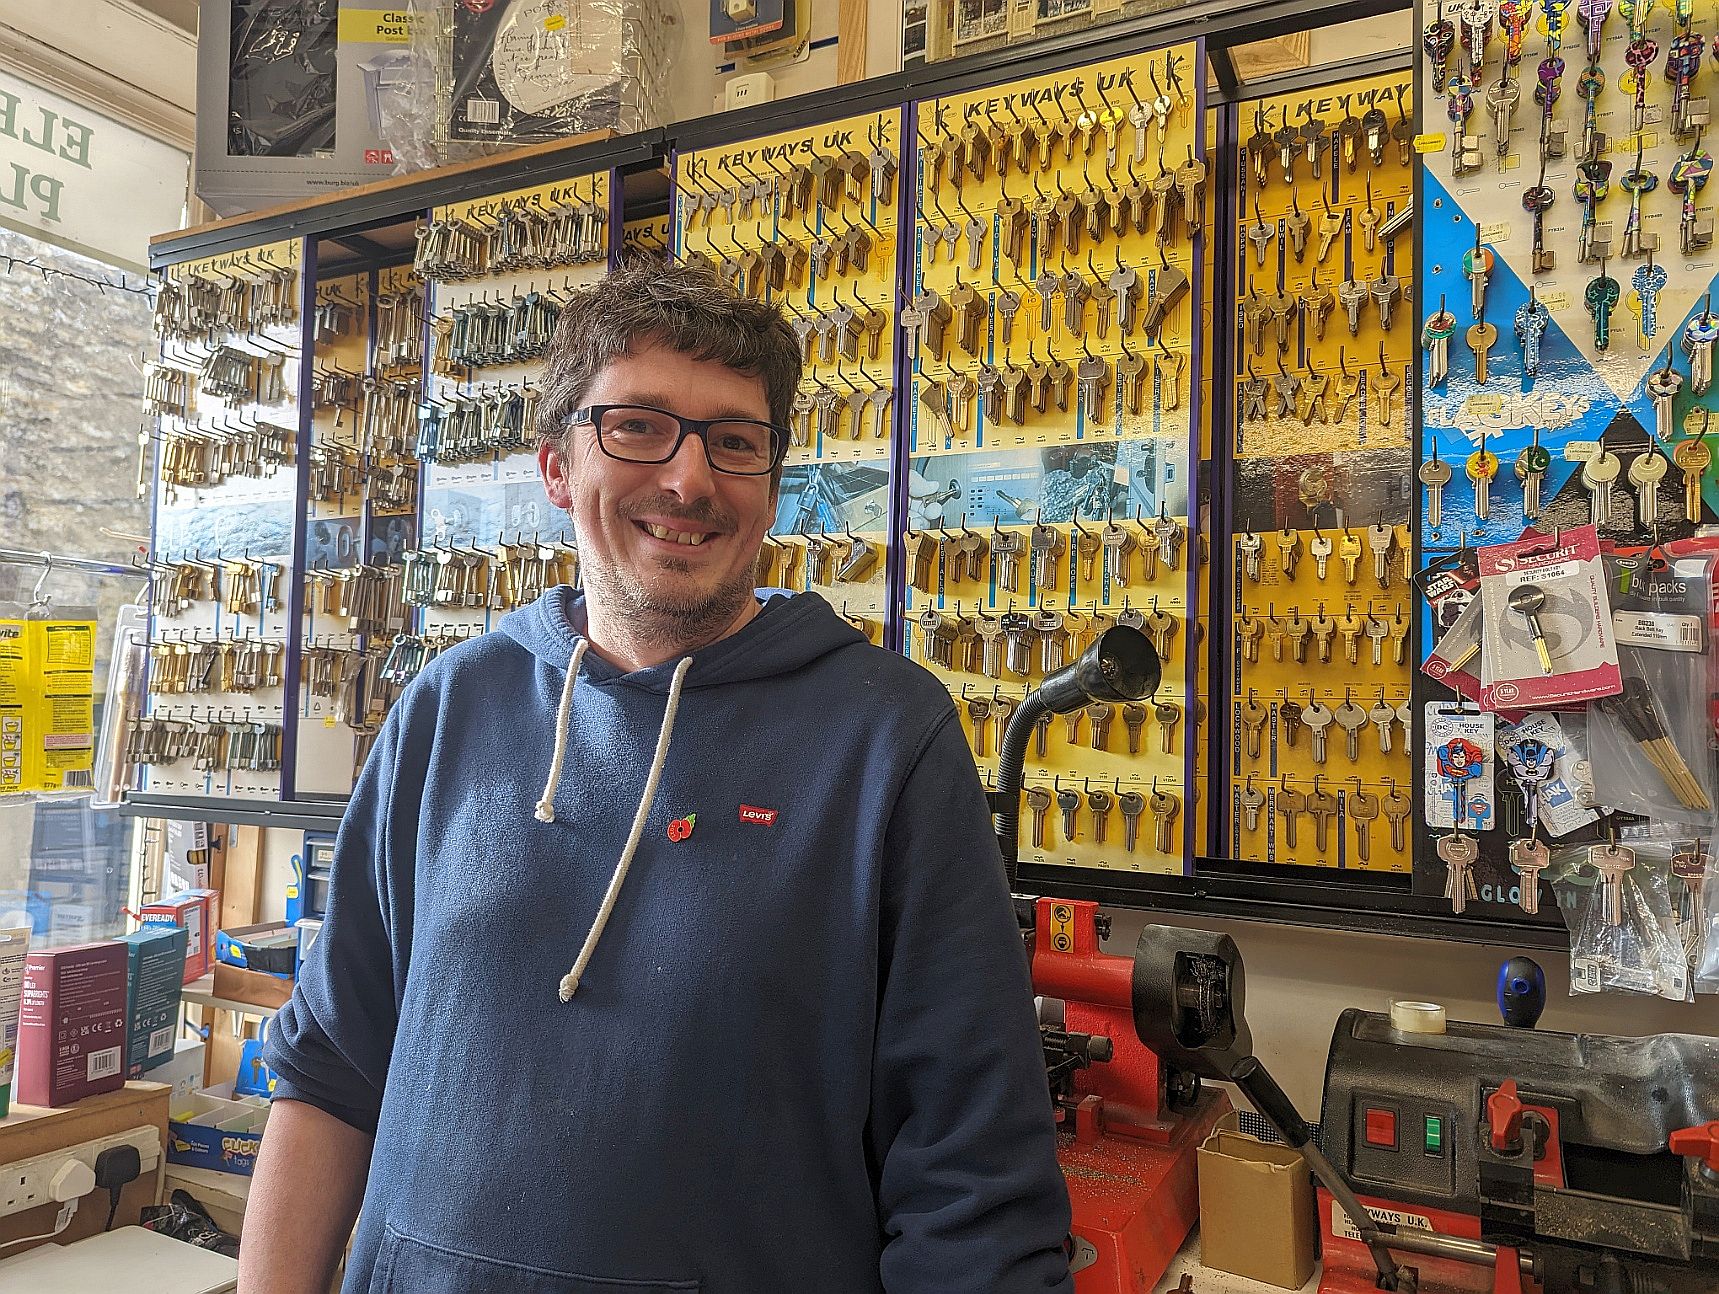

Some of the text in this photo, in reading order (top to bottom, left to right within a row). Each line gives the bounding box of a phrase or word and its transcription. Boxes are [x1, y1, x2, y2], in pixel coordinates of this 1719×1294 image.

[376, 25, 404, 35] Post
[967, 80, 1085, 117] KEYWAYS
[1100, 69, 1137, 92] UK
[1295, 83, 1412, 118] KEYWAY
[718, 139, 812, 170] KEYWAYS
[823, 131, 854, 148] UK
[467, 193, 541, 219] KEYWAYS
[550, 186, 574, 201] UK
[193, 253, 250, 273] KEYWAYS
[1519, 544, 1578, 565] SECURIT
[1427, 577, 1452, 592] STAR
[1520, 574, 1540, 583] REF:
[1425, 582, 1456, 598] WARS
[1648, 579, 1687, 597] packs
[1521, 719, 1547, 735] HOUSE
[1530, 727, 1545, 736] KEY
[141, 913, 175, 922] EVEREADY
[222, 1137, 259, 1155] CLICK
[1407, 1216, 1428, 1228] U.K.
